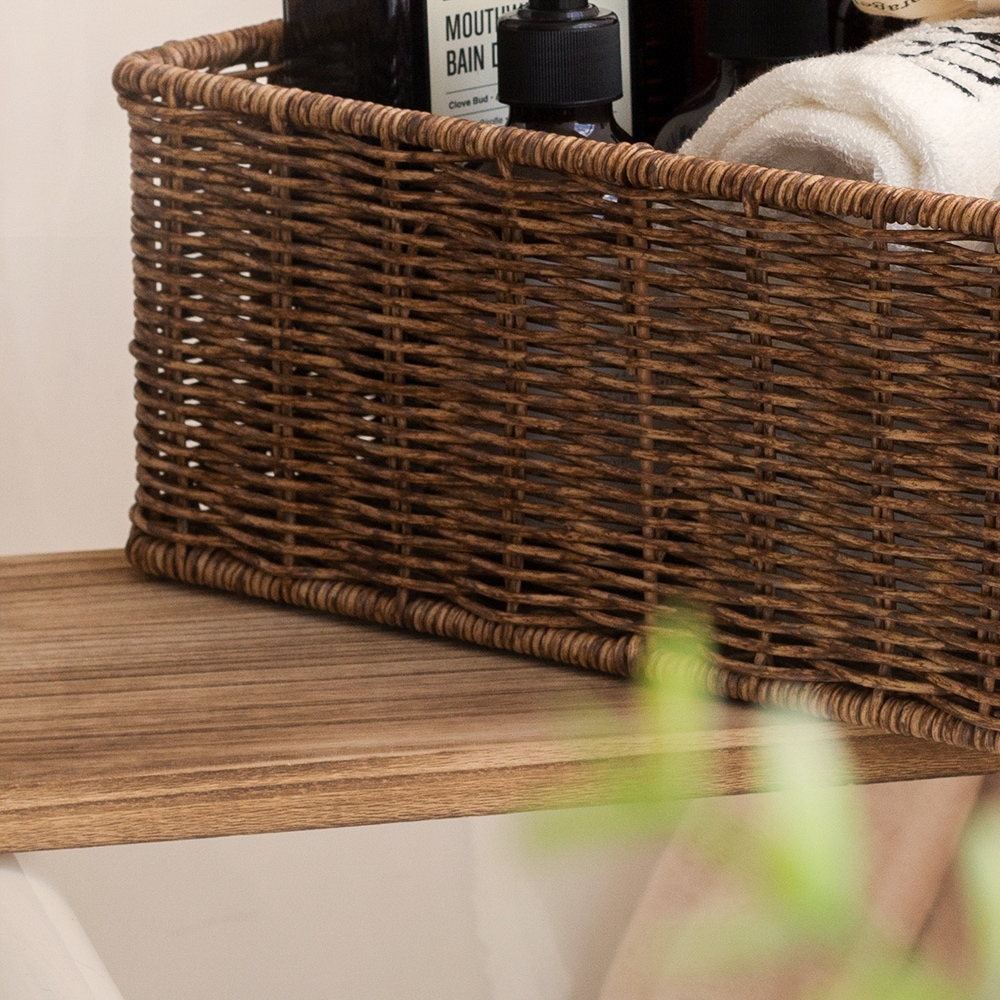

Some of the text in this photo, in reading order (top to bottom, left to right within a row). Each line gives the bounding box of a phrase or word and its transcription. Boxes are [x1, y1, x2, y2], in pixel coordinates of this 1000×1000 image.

[446, 44, 485, 77] BAIN
[448, 99, 472, 110] Clove
[472, 94, 489, 105] Bud
